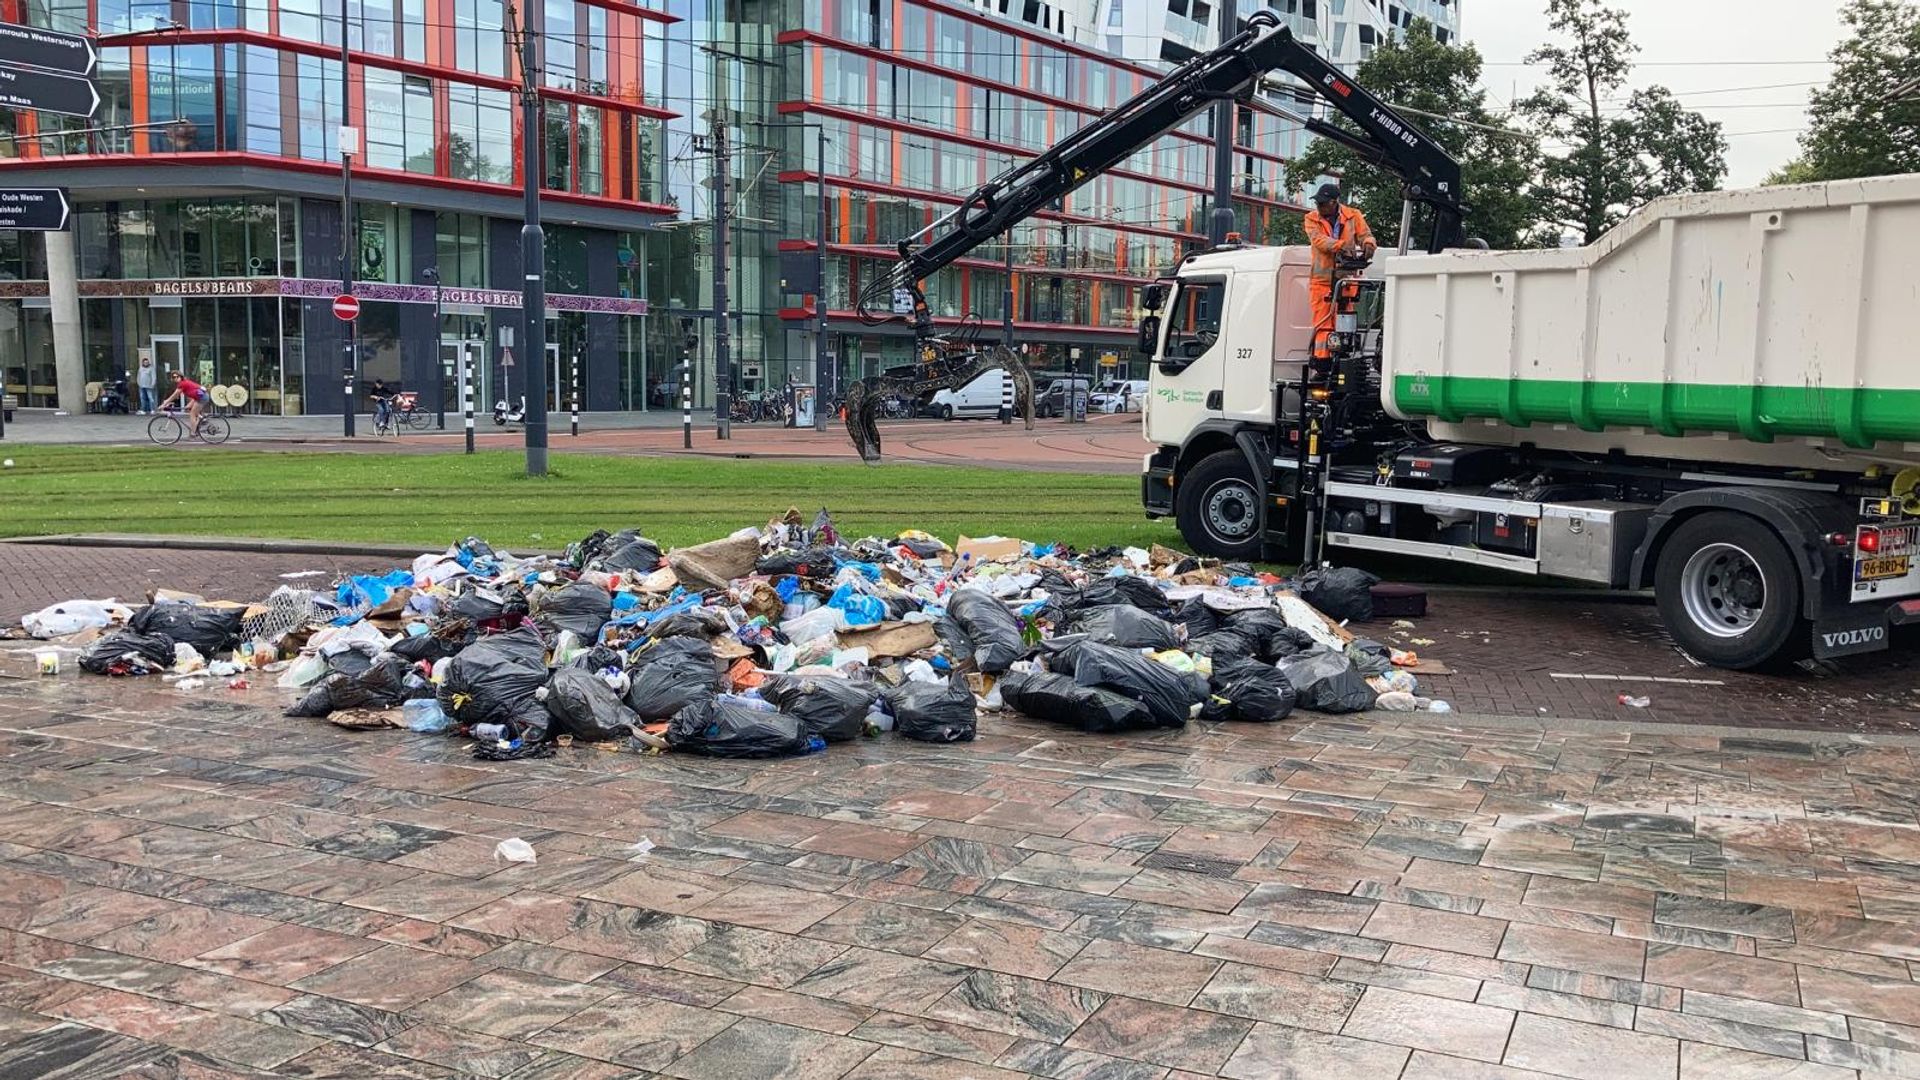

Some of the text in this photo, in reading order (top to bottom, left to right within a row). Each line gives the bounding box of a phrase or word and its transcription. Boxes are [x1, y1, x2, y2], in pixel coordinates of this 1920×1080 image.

[30, 32, 82, 48] Westersingel
[9, 95, 32, 105] Maas
[1401, 131, 1418, 147] 092
[1, 193, 19, 201] Oude
[154, 281, 202, 294] BAGELS
[211, 281, 253, 294] BEANS
[1236, 348, 1253, 359] 327
[1863, 558, 1906, 575] 96-BRD-4
[1822, 626, 1884, 648] VOLVO
